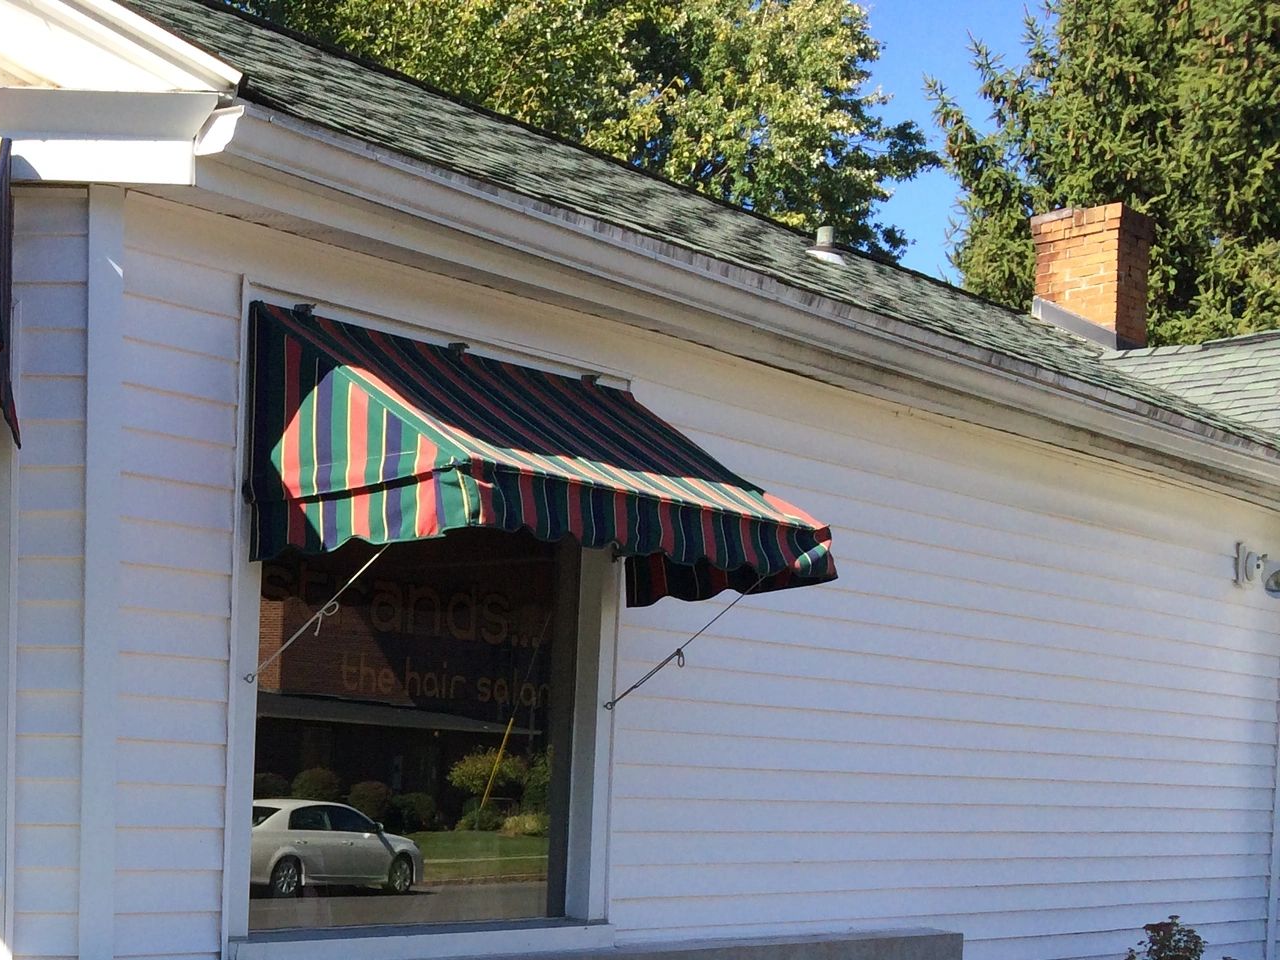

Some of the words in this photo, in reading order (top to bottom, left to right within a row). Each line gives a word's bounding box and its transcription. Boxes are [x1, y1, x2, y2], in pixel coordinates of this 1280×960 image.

[340, 650, 396, 693] the
[404, 656, 467, 699] hair
[476, 666, 550, 708] salon
